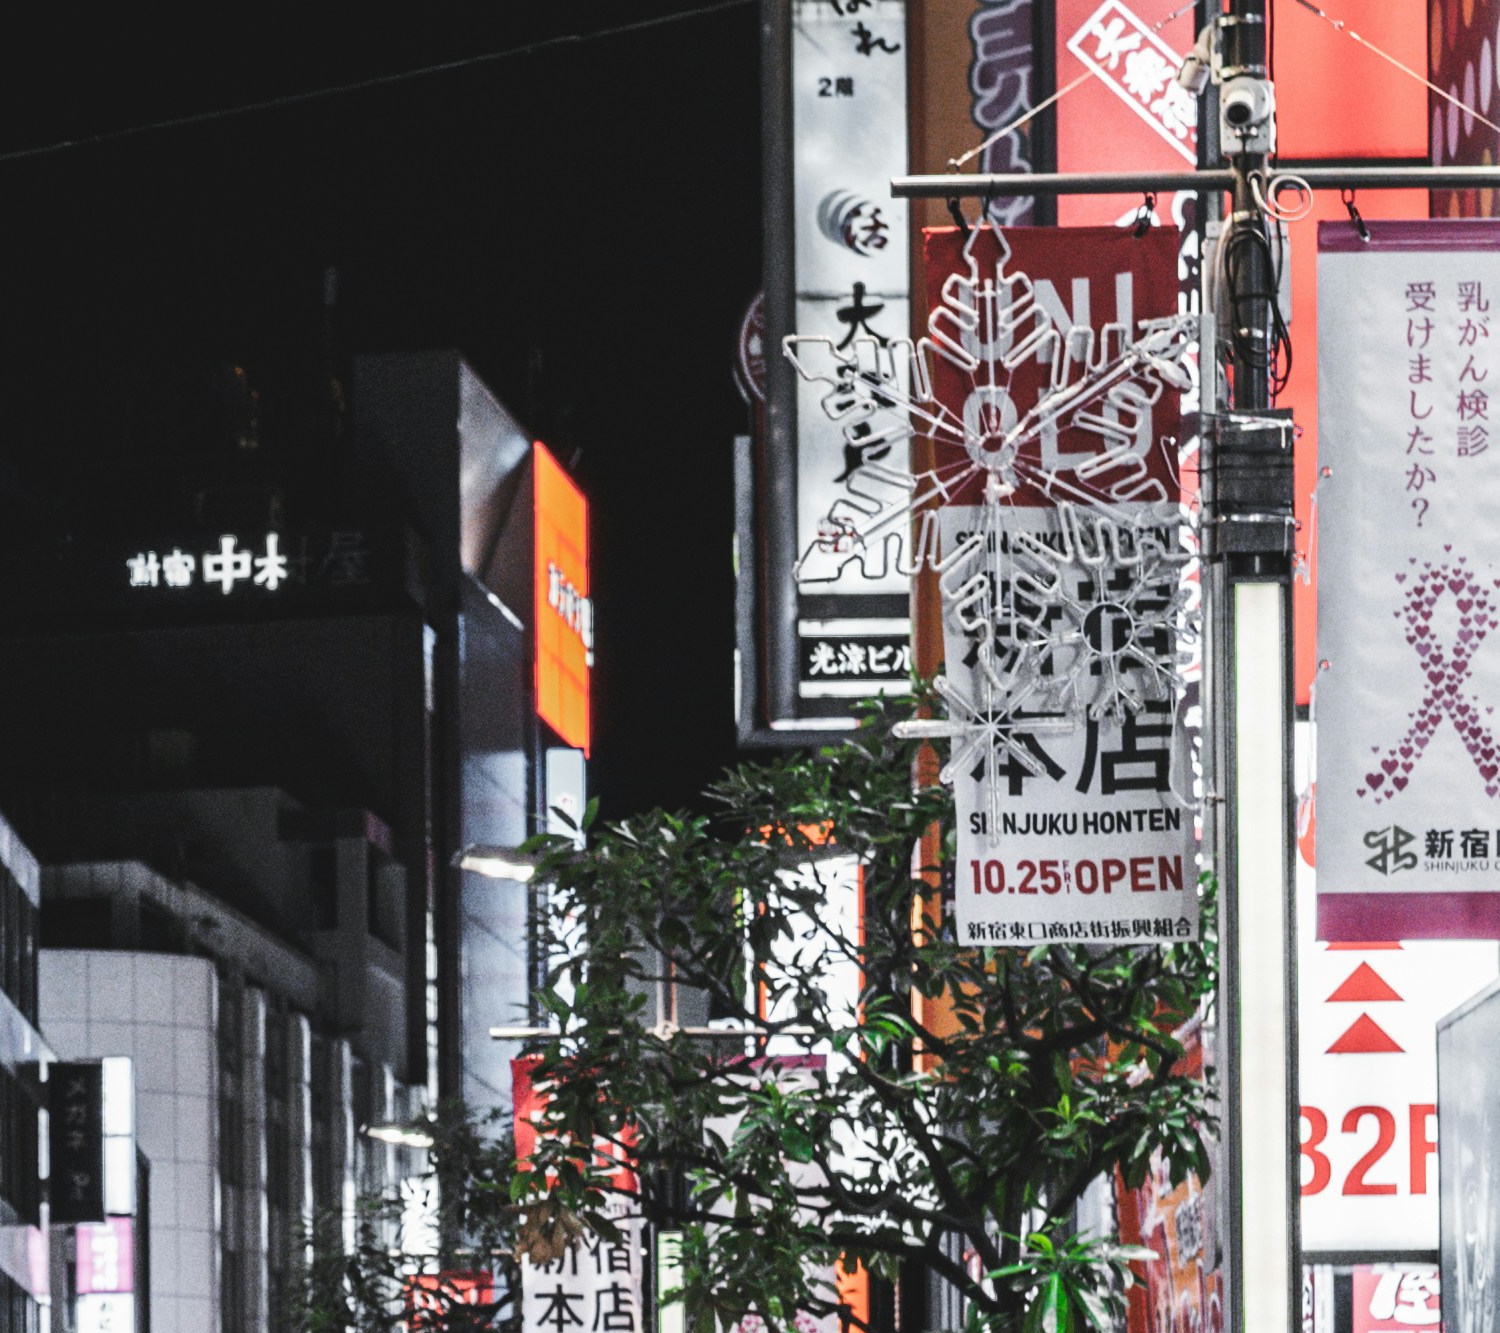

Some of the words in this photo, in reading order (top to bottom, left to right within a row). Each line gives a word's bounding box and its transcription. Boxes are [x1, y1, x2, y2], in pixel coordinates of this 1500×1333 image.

[818, 78, 854, 97] 2階
[1456, 281, 1490, 458] 乳がん検診
[1404, 281, 1437, 528] 受けましたか?
[968, 690, 1173, 798] 本店
[1082, 807, 1180, 834] HONTEN
[969, 859, 1061, 897] 10.25
[1074, 855, 1184, 893] OPEN
[1424, 861, 1489, 873] SHINJUKU
[967, 918, 1194, 941] 新宿東口商店街振興組合
[534, 1283, 635, 1333] 本店
